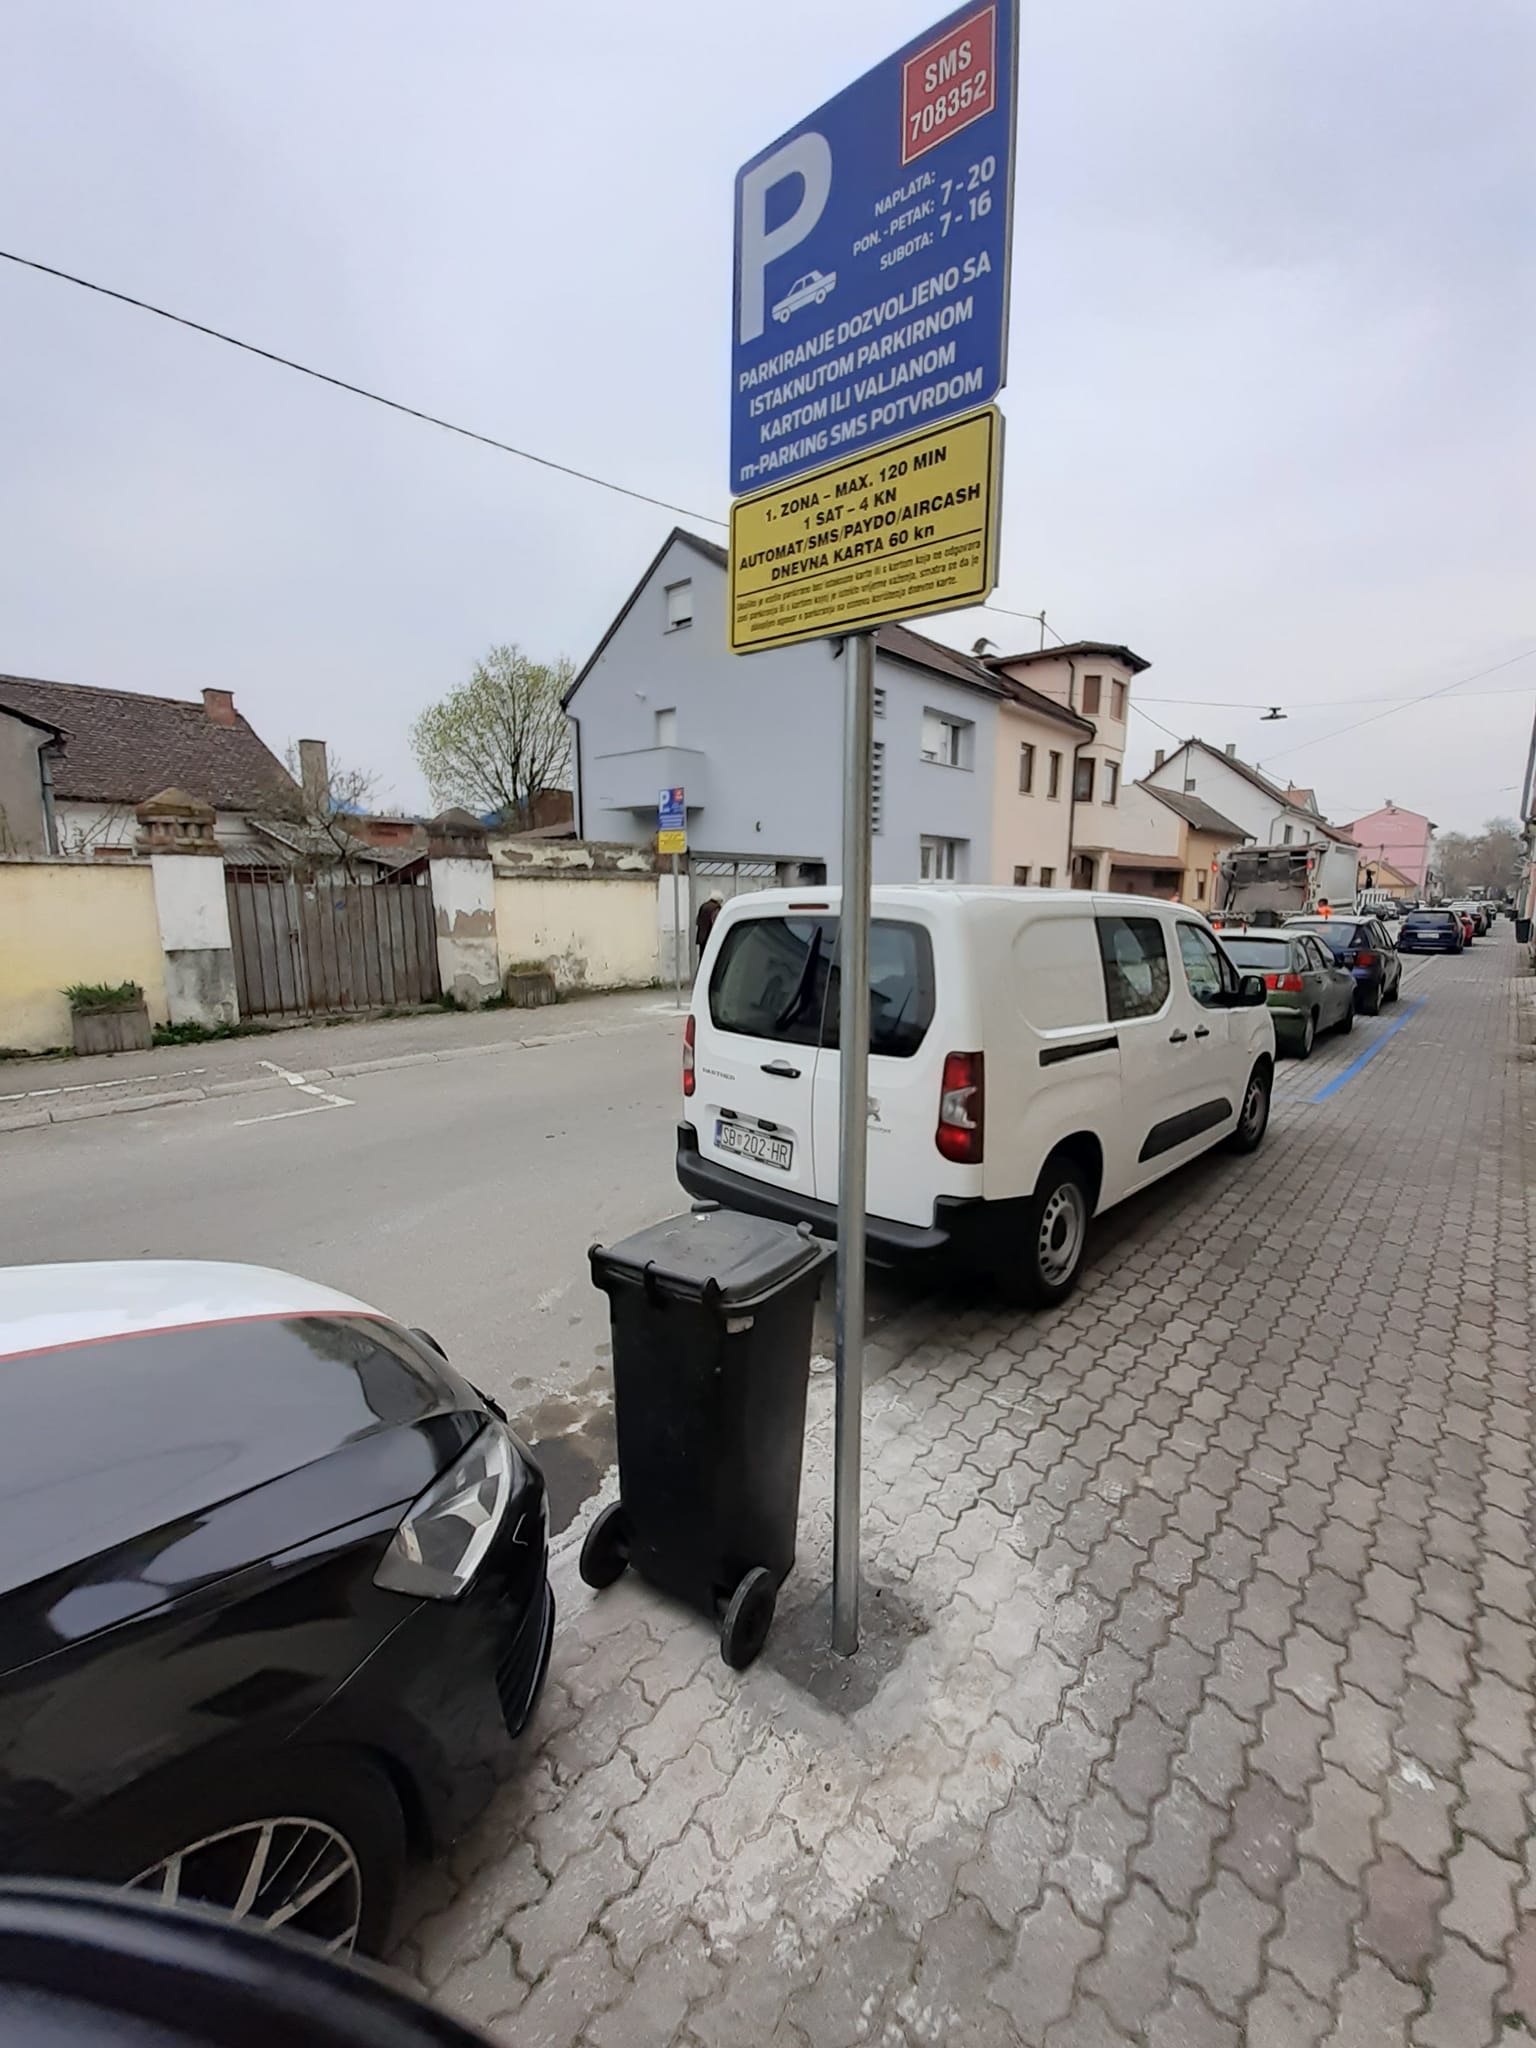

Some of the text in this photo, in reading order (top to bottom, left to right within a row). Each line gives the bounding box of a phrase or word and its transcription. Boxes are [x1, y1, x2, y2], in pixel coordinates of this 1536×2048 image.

[925, 40, 971, 92] SMS
[911, 70, 986, 142] 708352
[875, 171, 936, 216] NAPLATA:
[968, 155, 995, 184] 20
[969, 191, 991, 222] 16
[741, 132, 832, 345] P
[853, 232, 881, 256] PON.
[880, 232, 933, 270] SUBOTA:
[739, 251, 991, 392] PARKIRANJE DOZVOLJENO SA
[750, 296, 973, 418] ISTAKNUTOM PARKIRNOM
[760, 341, 955, 443] KARTOM ILI VALJANOM
[740, 367, 983, 481] m-PARKING SMS POTVRDOM
[766, 509, 776, 522] 1.
[781, 493, 819, 515] ZONA
[835, 474, 873, 499] MAX.
[879, 460, 908, 482] 120
[913, 446, 947, 471] MIN
[804, 517, 810, 530] 1
[816, 505, 843, 526] SAT
[859, 497, 869, 511] 4
[874, 488, 896, 508] KN
[772, 525, 934, 581] DNEVNA KARTA 60 kn
[723, 1127, 736, 1146] SB
